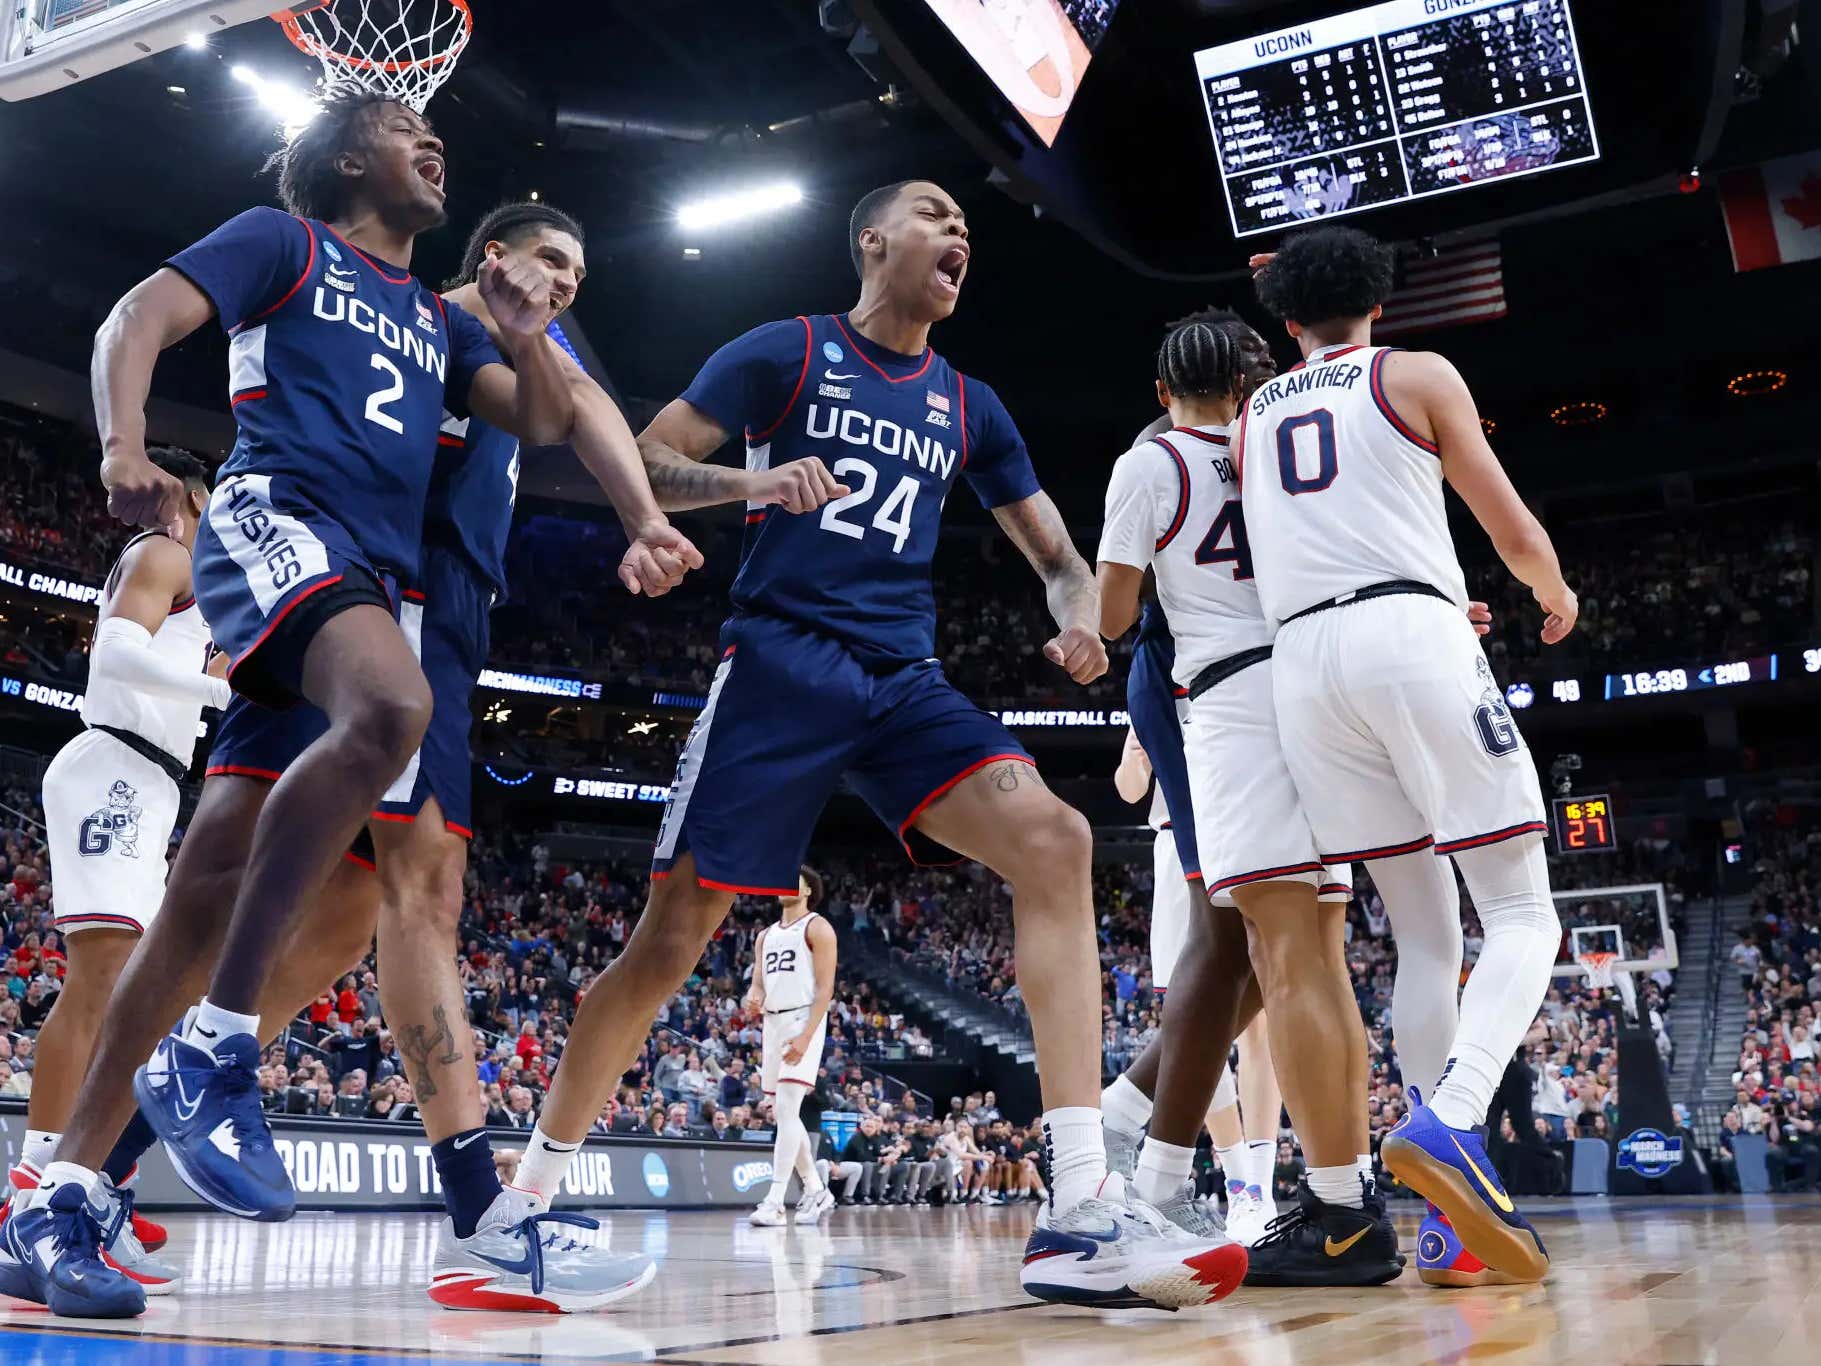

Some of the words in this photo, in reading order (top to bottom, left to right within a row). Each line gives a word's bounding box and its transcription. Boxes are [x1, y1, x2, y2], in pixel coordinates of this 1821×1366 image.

[1254, 29, 1313, 58] UCONN
[313, 286, 446, 384] UCONN
[364, 353, 404, 434] 2
[1252, 363, 1362, 416] STRAWTHER
[806, 403, 956, 480] UCONN
[1276, 407, 1339, 496] 0
[819, 457, 920, 554] 24
[224, 478, 302, 590] HUSKIES
[2, 678, 22, 696] VS
[1621, 668, 1688, 696] 16:39
[1714, 661, 1751, 685] 2ND
[1001, 711, 1106, 726] BASKETBALL
[1473, 704, 1520, 757] G
[577, 780, 638, 800] SWEET
[78, 816, 112, 857] G
[1568, 818, 1605, 847] 27
[766, 949, 796, 975] 22
[273, 1139, 361, 1193] ROAD
[367, 1143, 408, 1194] TO
[555, 1152, 615, 1196] OUR
